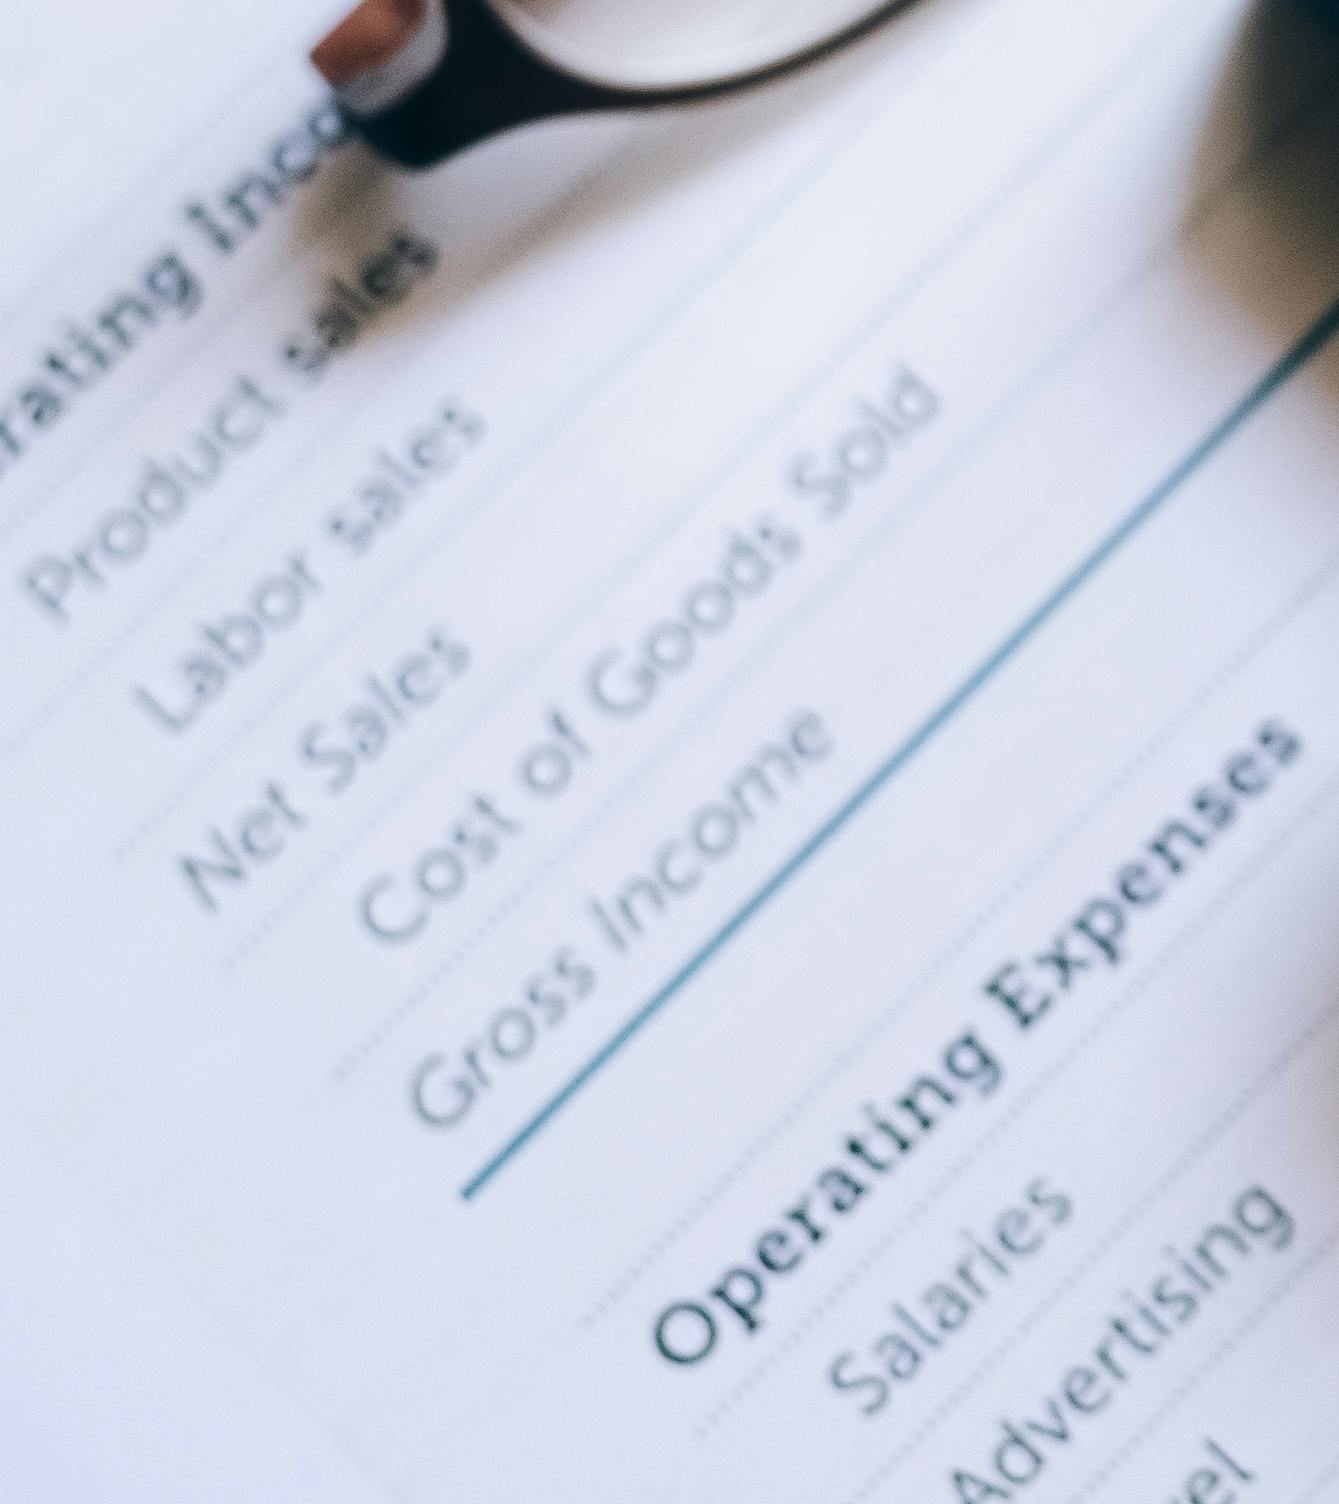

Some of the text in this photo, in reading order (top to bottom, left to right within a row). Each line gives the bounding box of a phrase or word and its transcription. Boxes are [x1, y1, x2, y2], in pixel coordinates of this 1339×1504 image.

[0, 97, 347, 472] rating Inco
[22, 232, 440, 626] Product sales
[135, 392, 487, 734] Labor sales
[357, 365, 942, 948] Cost of Goods Sold
[177, 623, 472, 917] Net Sales
[409, 704, 836, 1133] Gross Income
[652, 715, 1306, 1369] Operating Expenses
[829, 1174, 1076, 1420] Salaries
